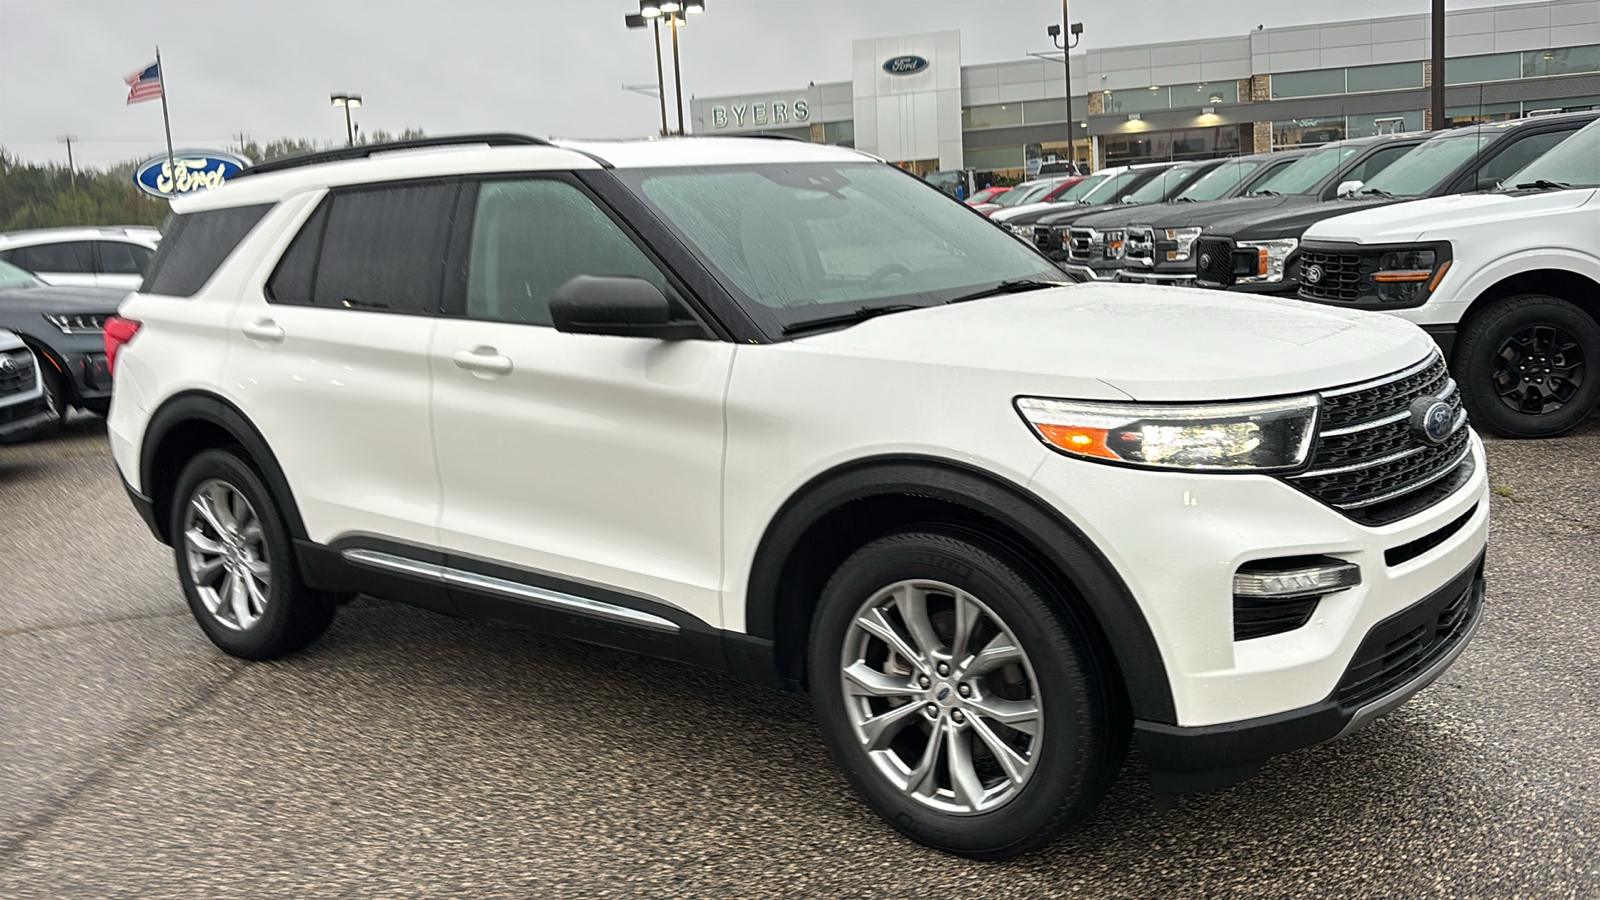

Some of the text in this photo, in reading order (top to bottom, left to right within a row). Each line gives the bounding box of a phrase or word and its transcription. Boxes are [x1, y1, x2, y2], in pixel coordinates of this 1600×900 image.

[891, 57, 918, 72] Ford
[711, 98, 810, 129] BYERS
[156, 157, 226, 194] Ford
